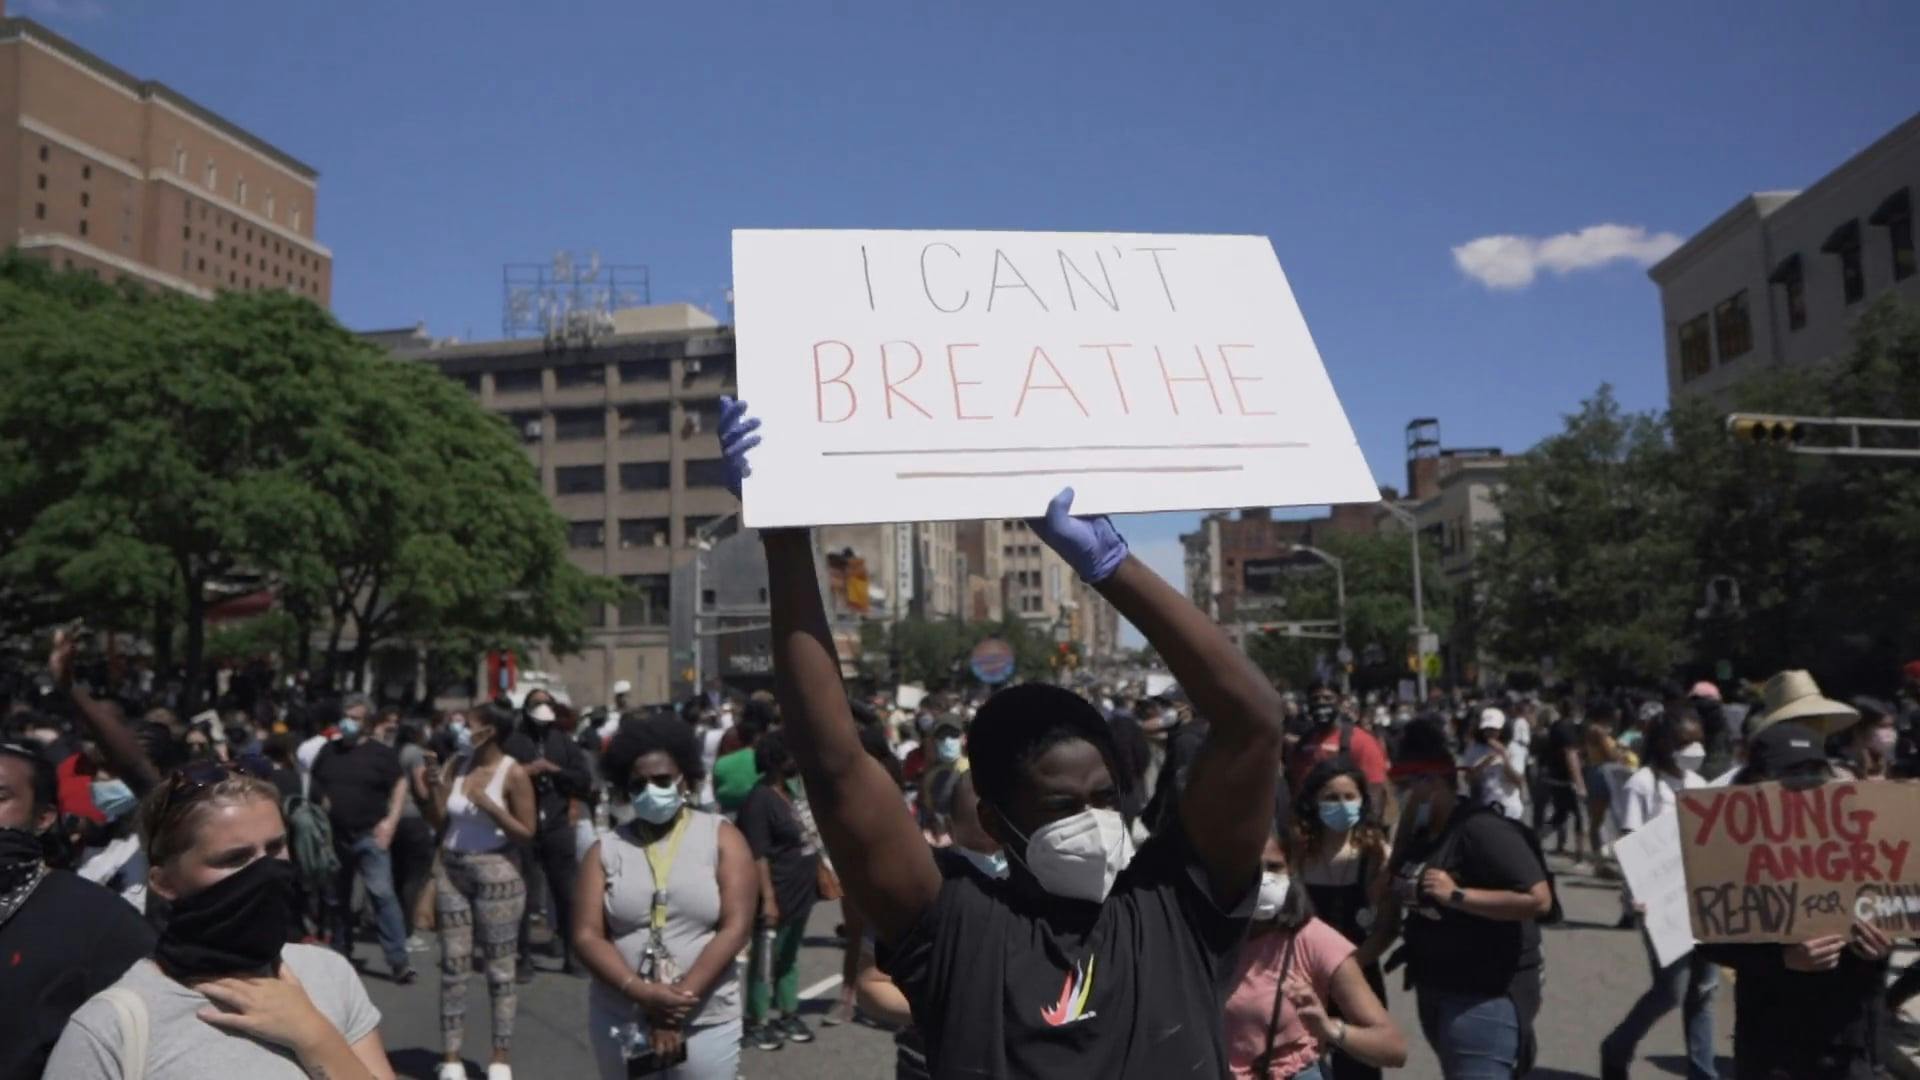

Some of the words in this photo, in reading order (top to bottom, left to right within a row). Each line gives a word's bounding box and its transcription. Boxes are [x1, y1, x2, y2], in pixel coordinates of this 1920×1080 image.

[861, 245, 875, 311] I
[920, 242, 1177, 312] CAN'T
[812, 340, 1276, 423] BREATHE
[1682, 786, 1876, 846] YOUNG
[1745, 841, 1911, 884] ANGRY
[1693, 882, 1798, 936] READY
[1801, 890, 1847, 918] FOR
